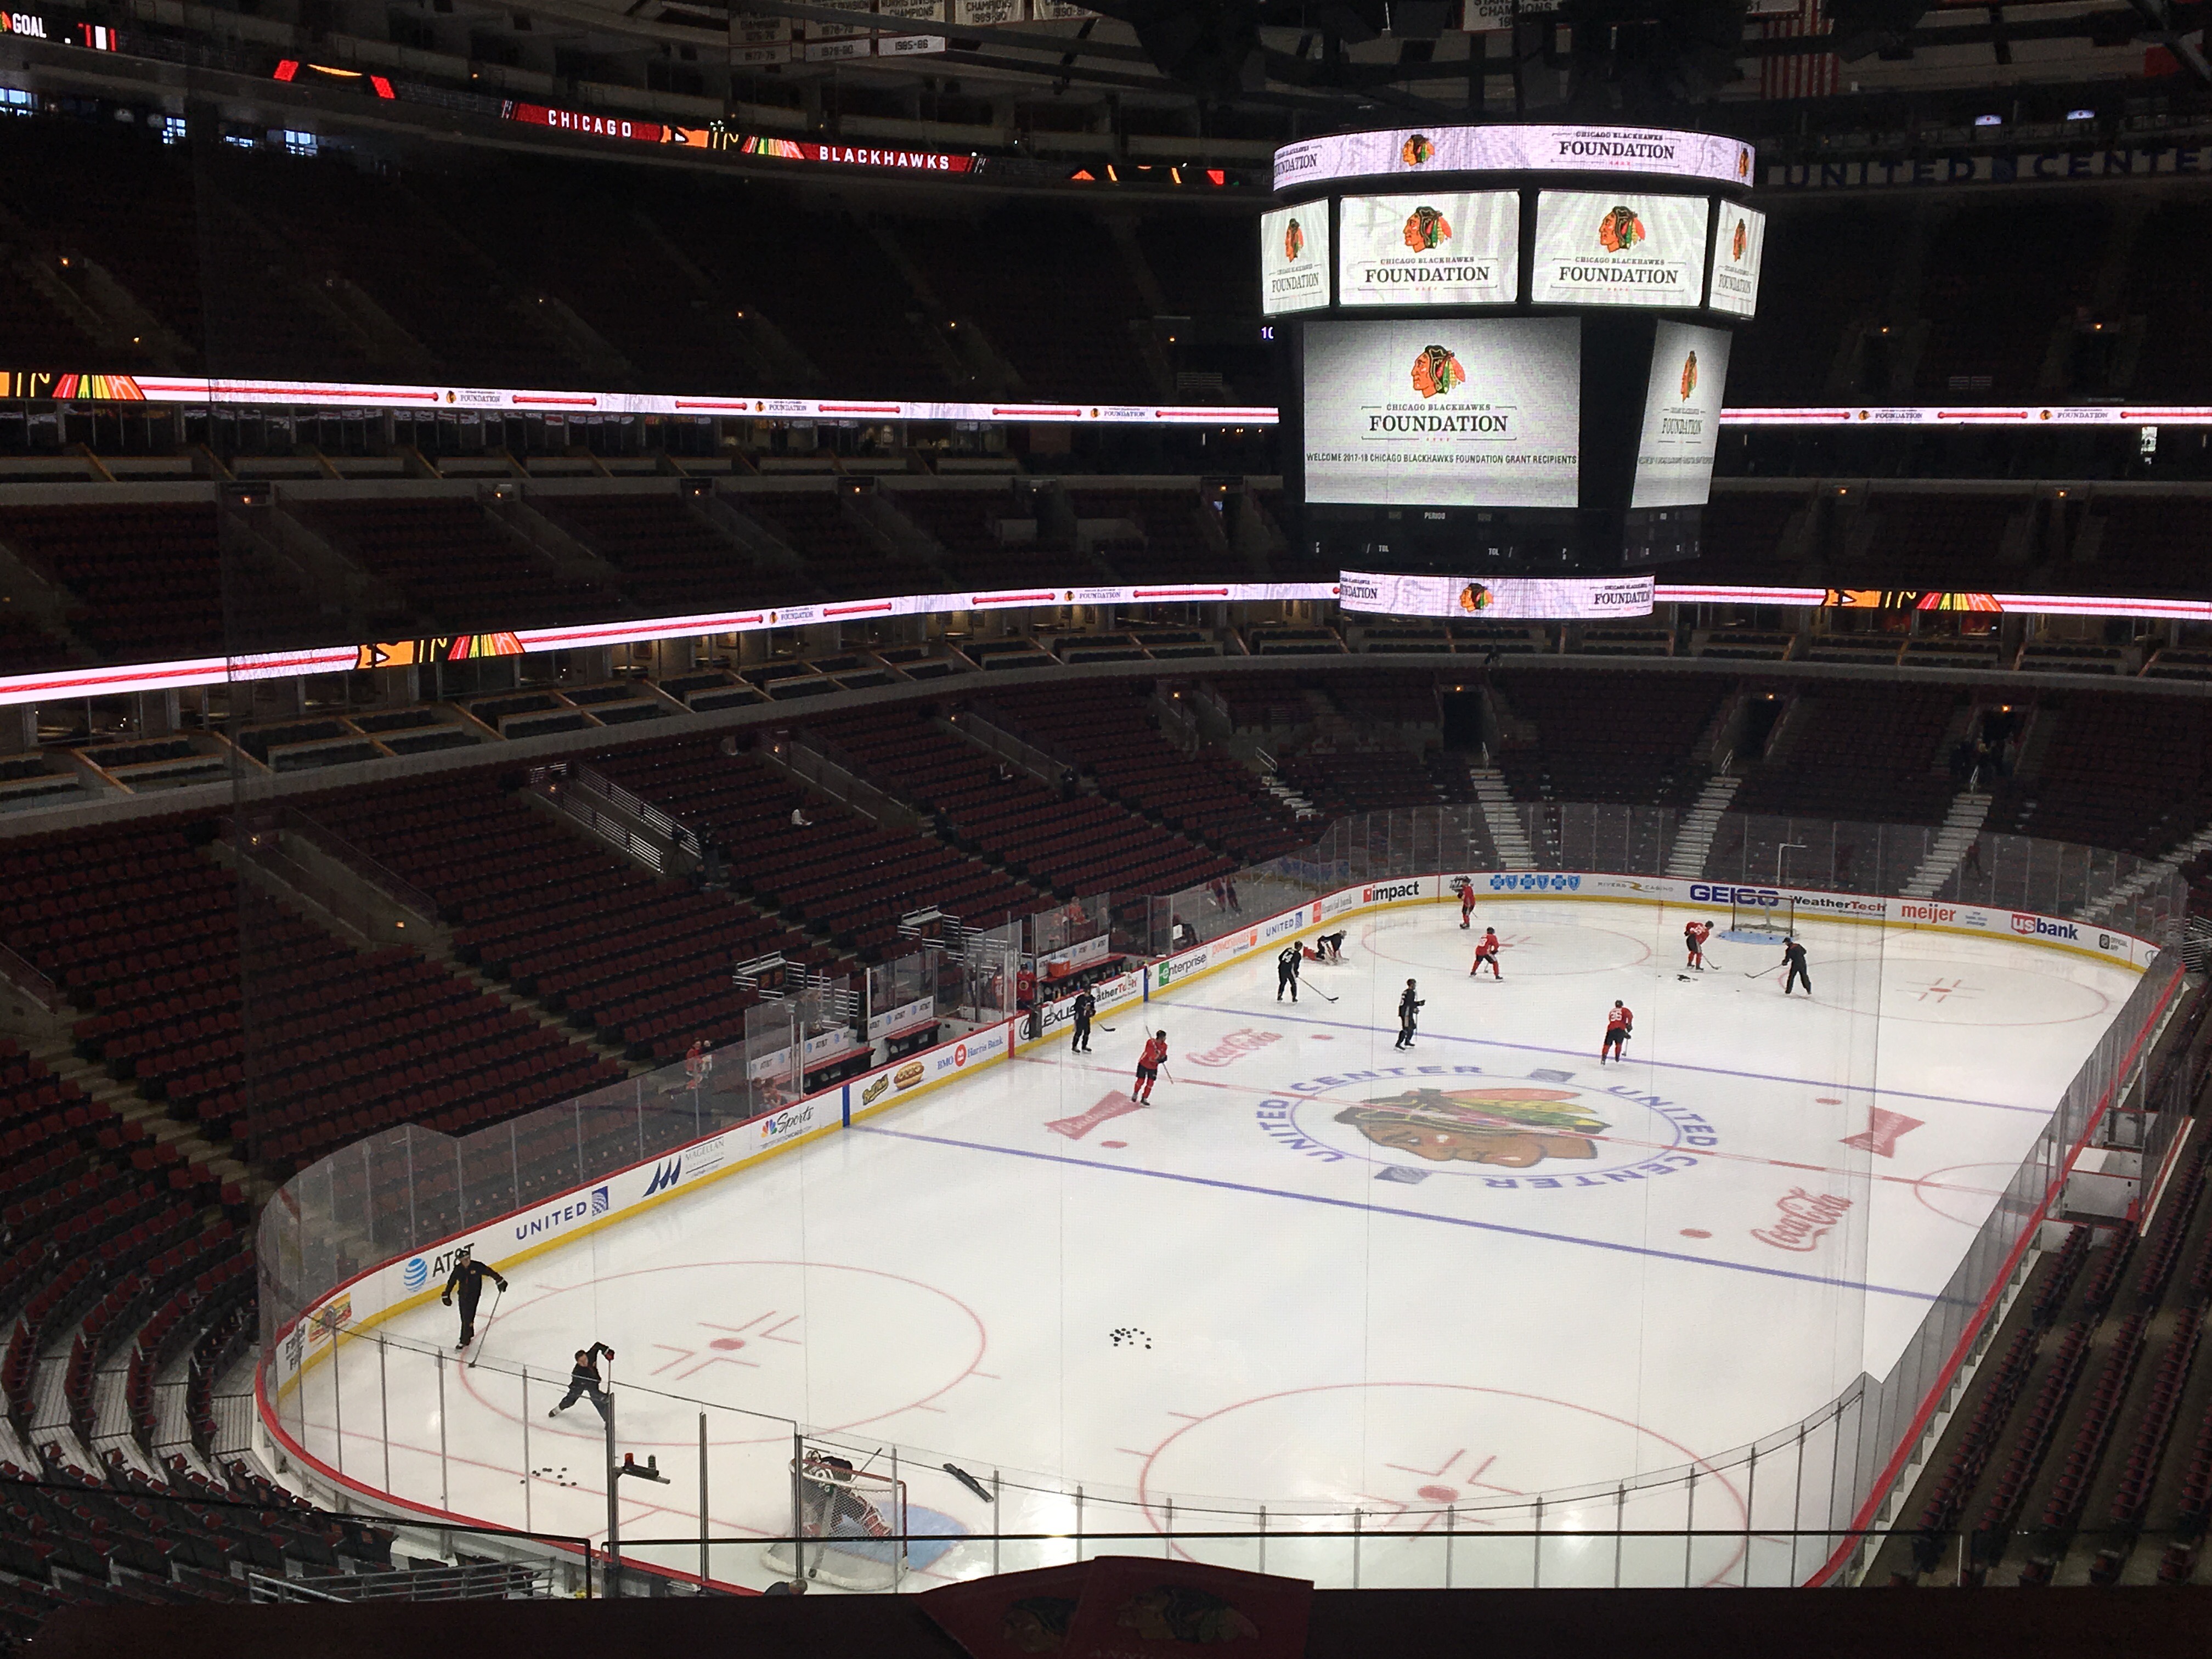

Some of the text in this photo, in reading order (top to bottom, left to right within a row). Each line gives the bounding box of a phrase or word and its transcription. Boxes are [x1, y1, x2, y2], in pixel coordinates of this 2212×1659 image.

[12, 13, 47, 39] GOAL
[895, 39, 928, 51] 1985-86
[548, 110, 949, 170] CHICAGO BLACKHAWKS
[1612, 132, 1663, 141] BLACKHAWKS
[1559, 141, 1675, 159] FOUNDATION
[1785, 149, 2212, 187] UNITED CENTE
[1575, 256, 1610, 264] CHICAGO
[1272, 273, 1319, 293] FOUNDATION
[1365, 267, 1491, 283] FOUNDATION
[1559, 267, 1679, 284] FOUNDATION
[1369, 415, 1509, 432] FOUNDATION
[1306, 453, 1577, 465] WELCOME 2017-18 CHICAGO BLACKHAWKS FOUNDATION GRANT RECIPIENTS
[1372, 881, 1419, 902] impact
[1690, 884, 1779, 907] GEICO
[1789, 895, 1886, 912] WeatherTech
[1901, 904, 1956, 924] meijer
[1266, 918, 1294, 937] UNITED
[1159, 953, 1206, 979] enterprise
[1042, 1005, 1076, 1029] EXUS
[937, 1036, 1003, 1070] BMO Harris Bank
[776, 1105, 814, 1133] Sports
[1256, 1065, 1482, 1163] UNITED CENTER
[1482, 1085, 1718, 1188] UNITED CENTER
[516, 1201, 587, 1240] UNITED
